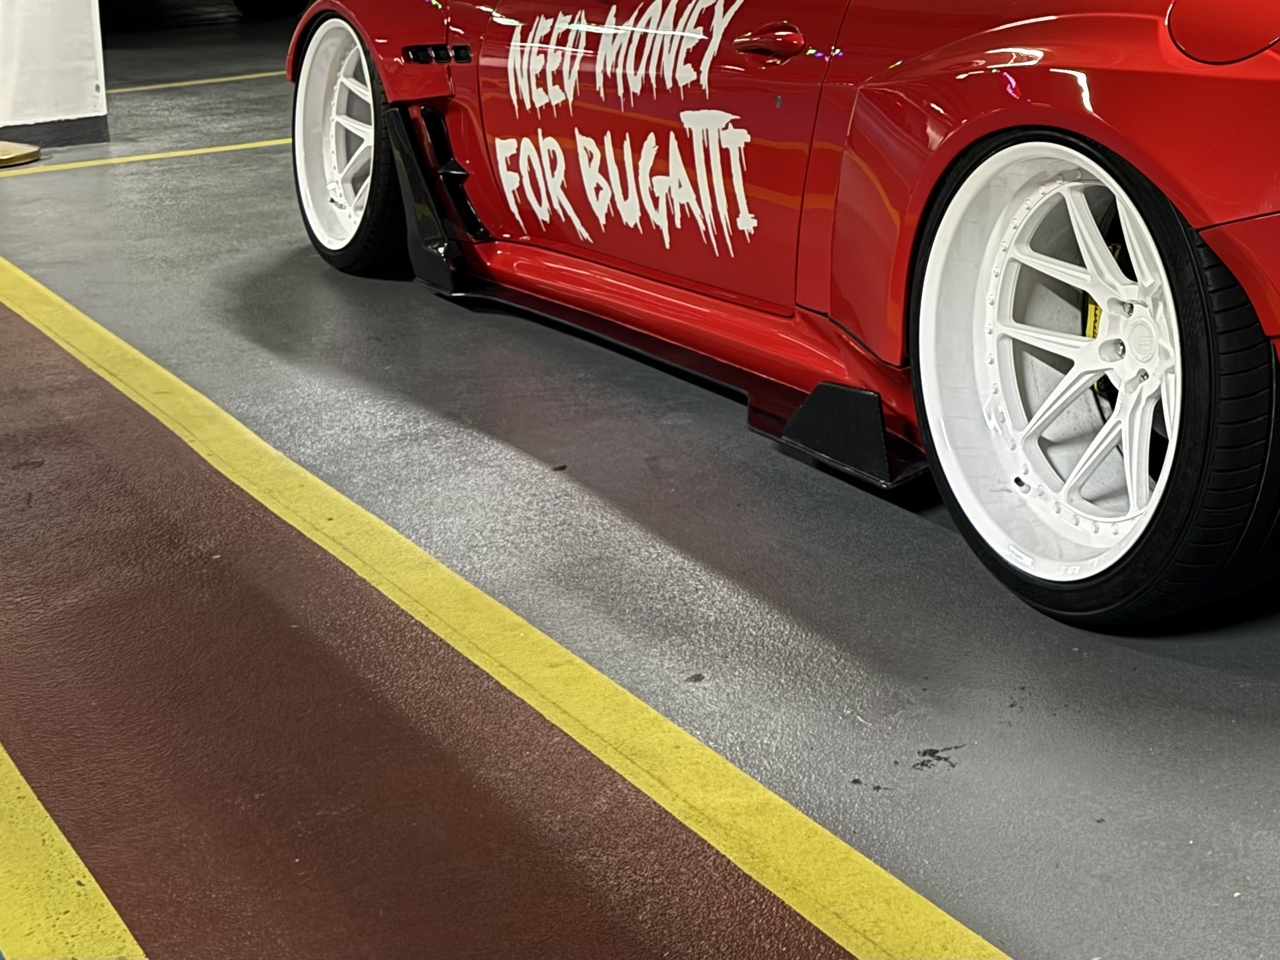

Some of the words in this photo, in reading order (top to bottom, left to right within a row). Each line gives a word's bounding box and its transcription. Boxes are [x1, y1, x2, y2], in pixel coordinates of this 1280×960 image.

[507, 9, 587, 120] NEED
[494, 127, 594, 244] FOR
[574, 108, 758, 258] BUGATTI
